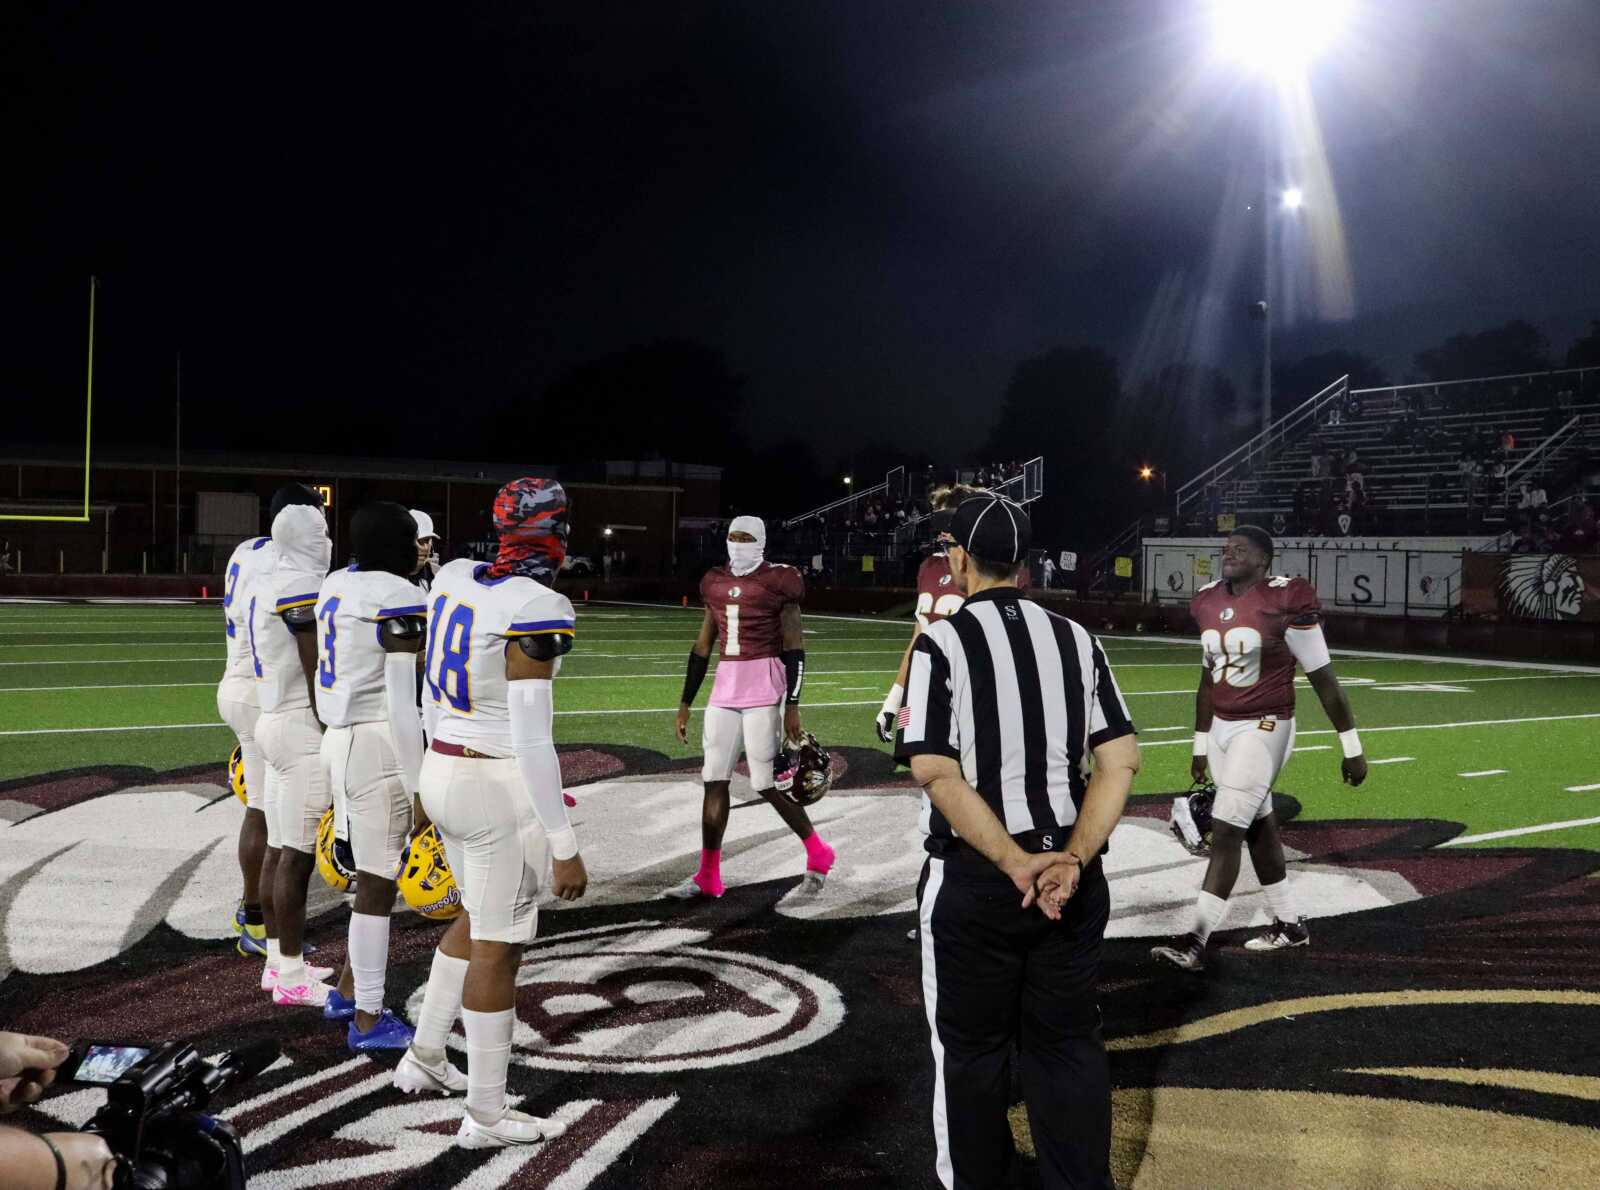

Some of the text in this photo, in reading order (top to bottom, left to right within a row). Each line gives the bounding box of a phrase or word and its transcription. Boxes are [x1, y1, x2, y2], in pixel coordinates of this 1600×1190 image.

[1351, 574, 1373, 604] S
[318, 594, 342, 691] 3
[424, 592, 476, 716] 18
[724, 603, 741, 656] 1
[1042, 834, 1054, 850] S
